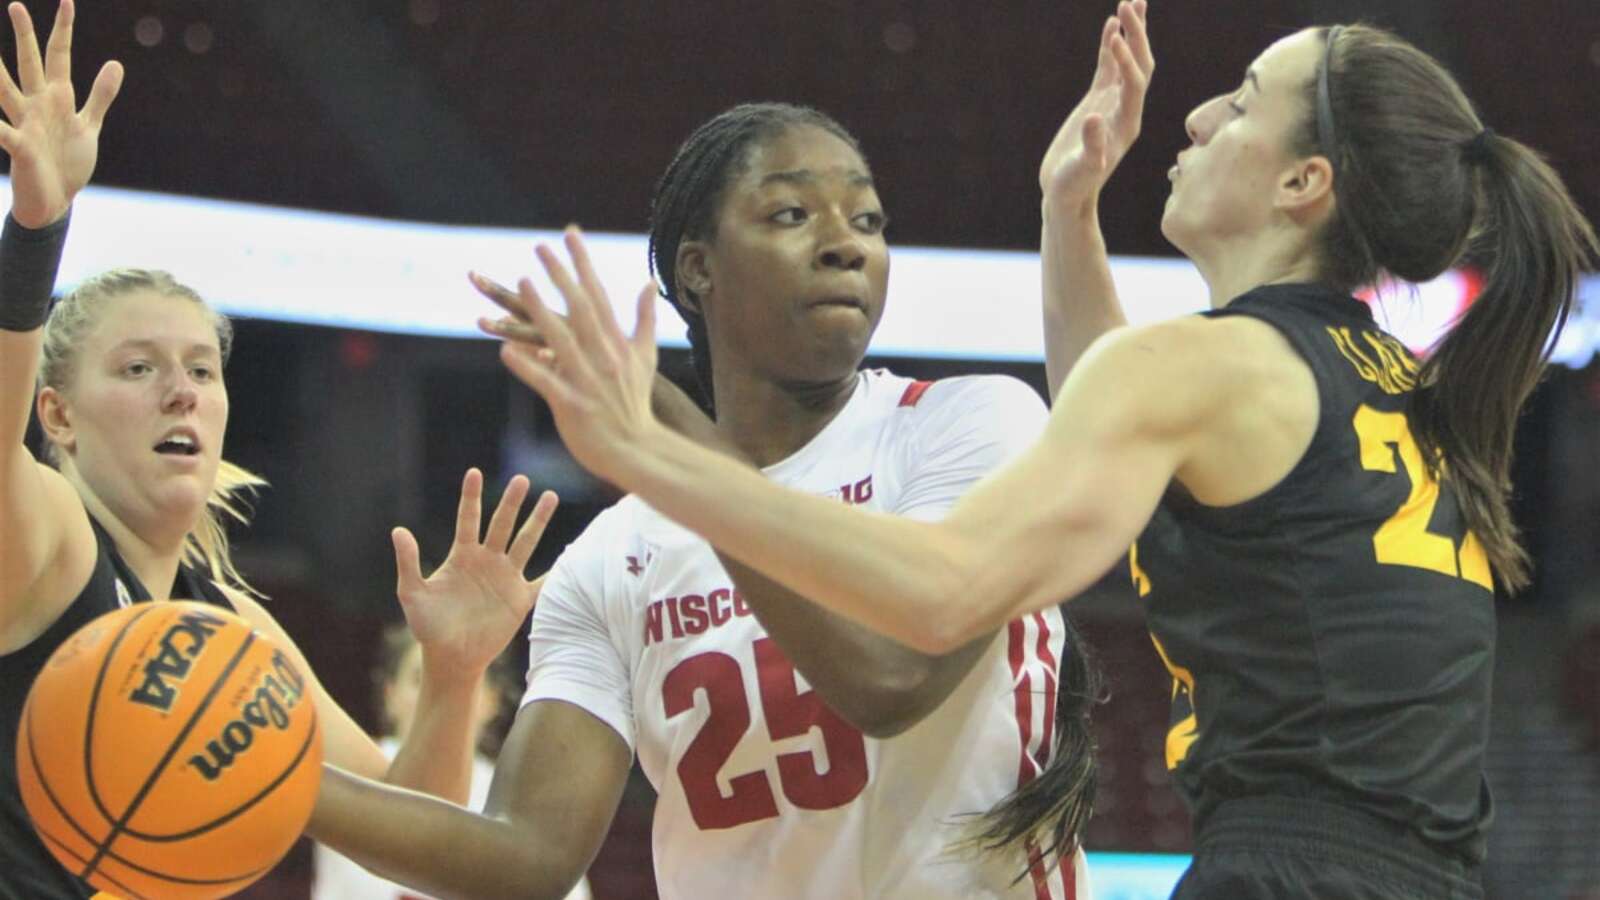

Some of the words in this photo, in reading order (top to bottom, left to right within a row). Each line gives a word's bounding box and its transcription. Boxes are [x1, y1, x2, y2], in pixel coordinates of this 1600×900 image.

[1353, 403, 1494, 592] 2
[129, 610, 227, 710] NCAA
[644, 588, 754, 646] WISCO
[188, 648, 304, 780] Wilson
[662, 638, 869, 830] 25
